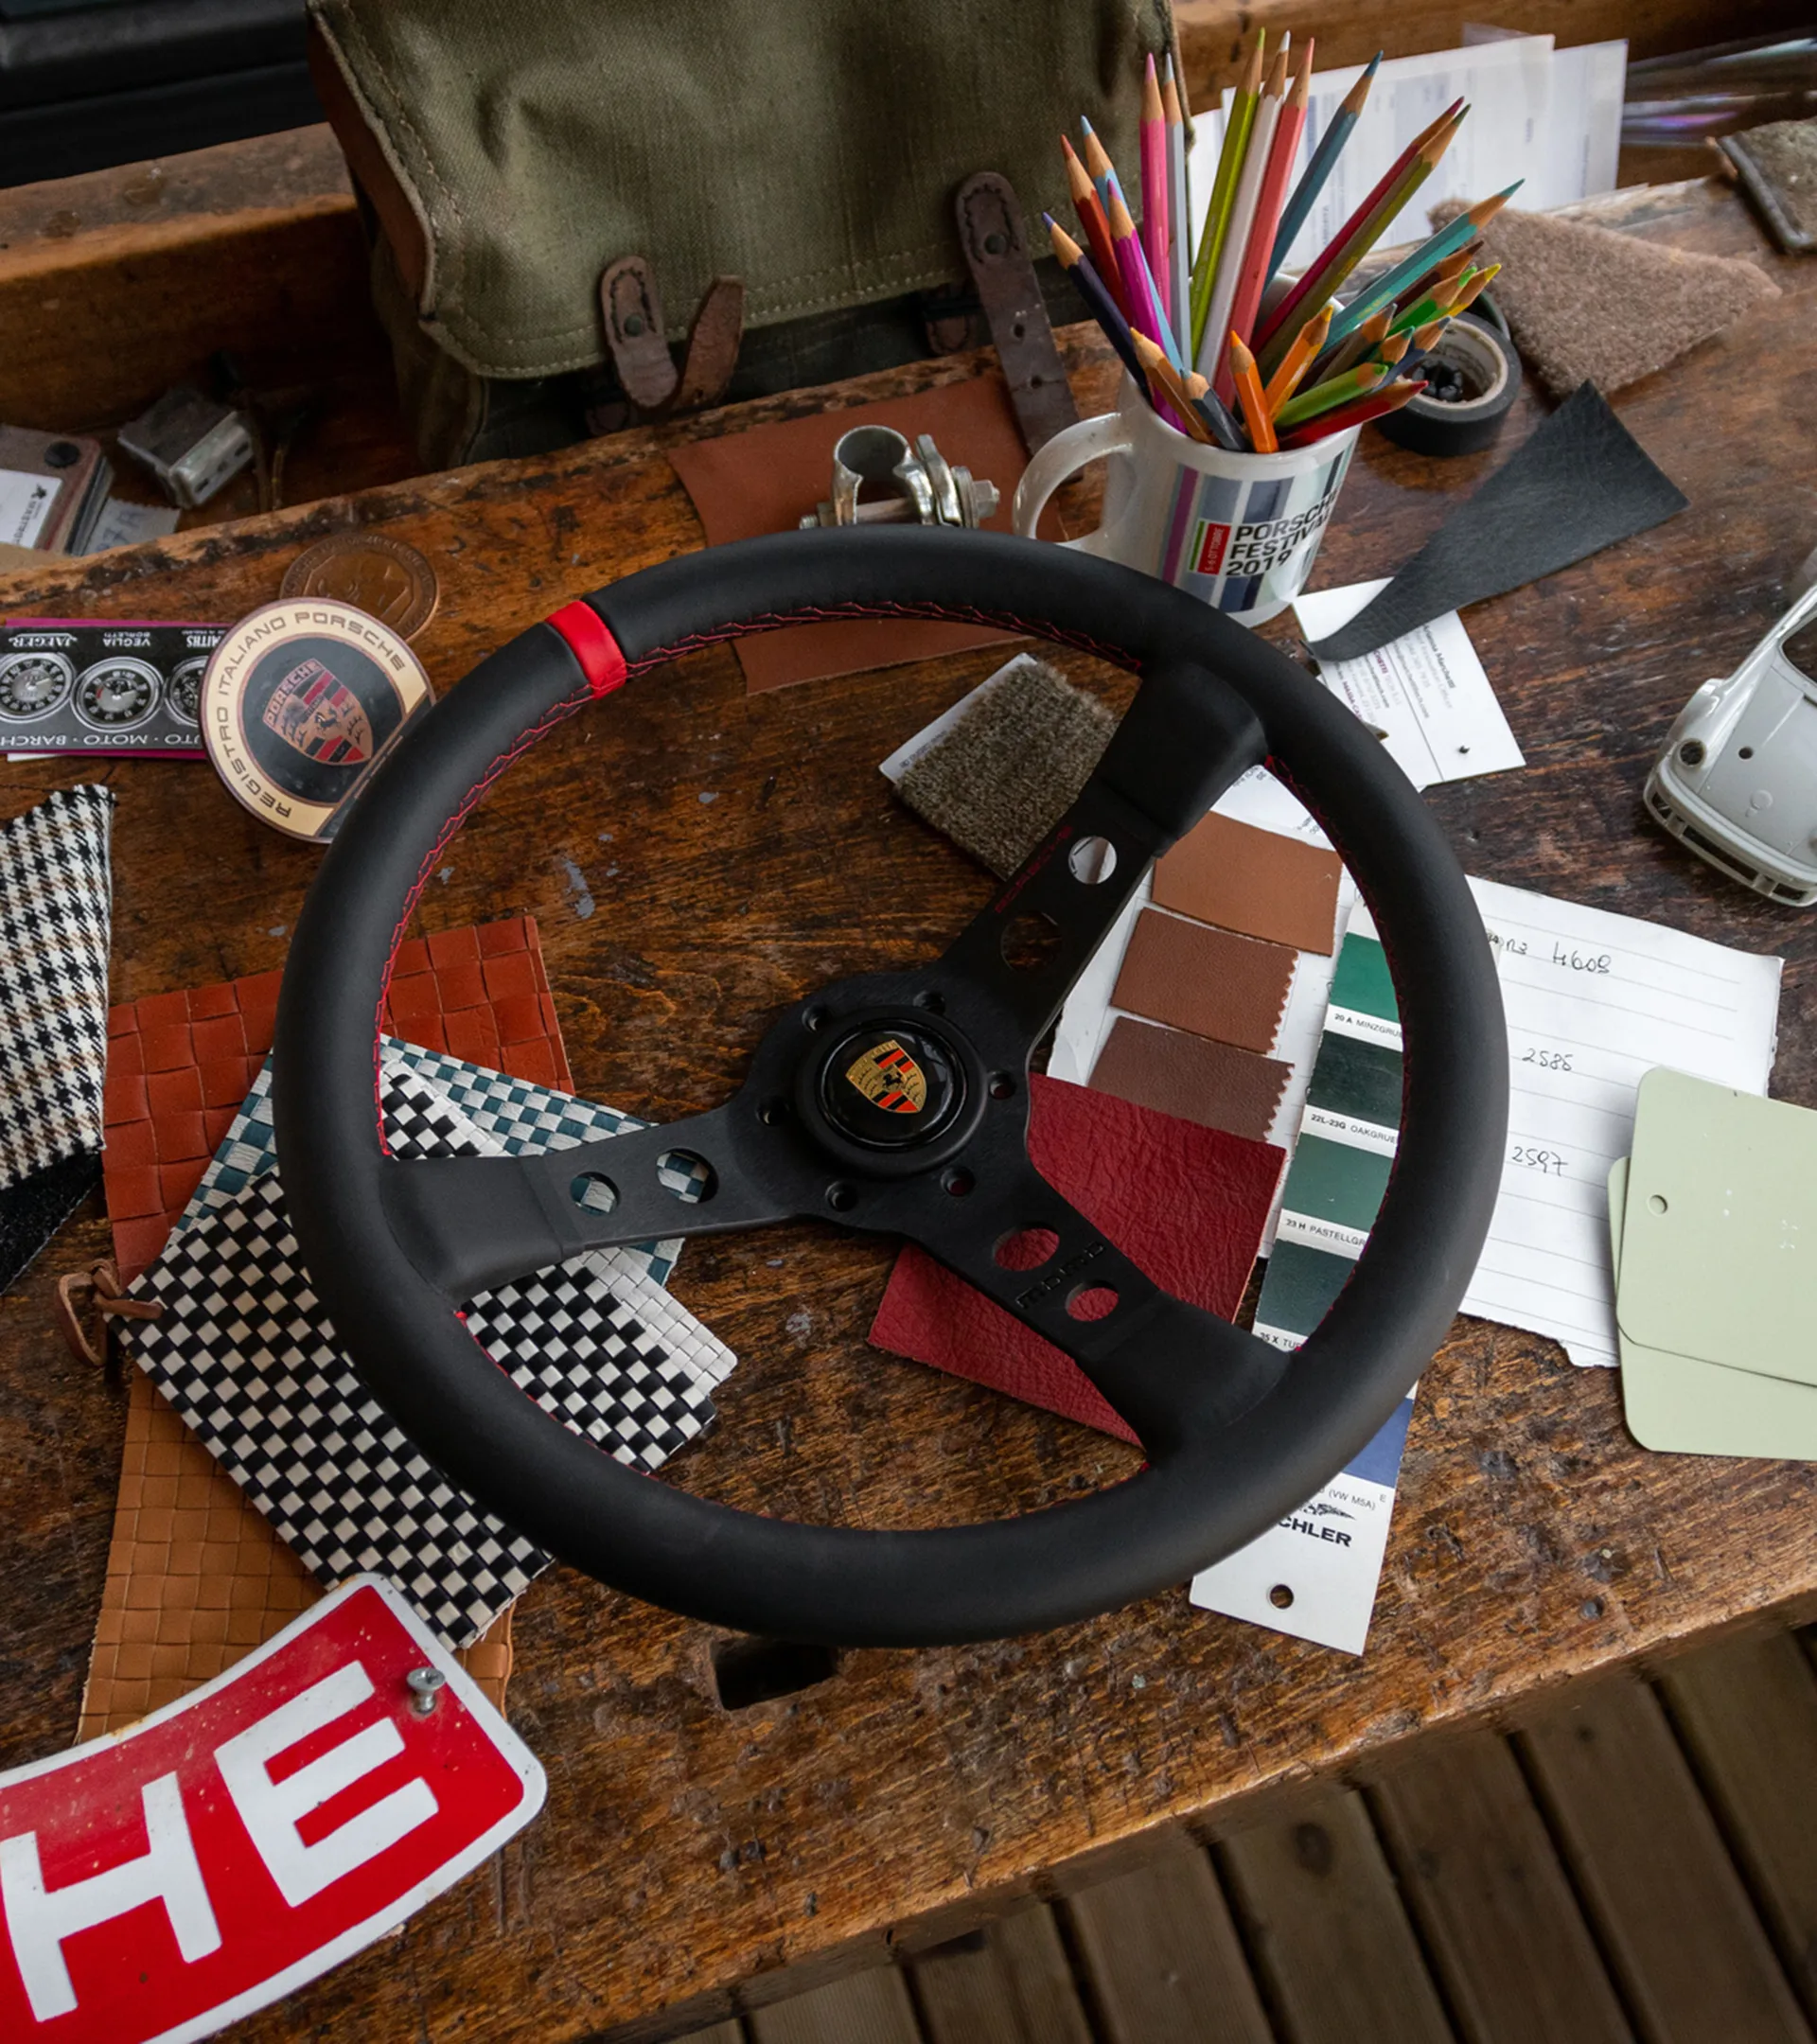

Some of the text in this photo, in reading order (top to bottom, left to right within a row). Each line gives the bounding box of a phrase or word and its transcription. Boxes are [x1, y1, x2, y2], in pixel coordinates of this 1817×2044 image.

[1226, 549, 1293, 576] 2019
[9, 635, 77, 648] JAEGER
[103, 638, 151, 647] VEGLIA
[294, 611, 406, 671] PORSCHE
[218, 616, 287, 696] ITALIANO
[266, 661, 323, 727] PORSCHE
[0, 733, 67, 747] BARCH
[83, 733, 148, 746] MOTO
[217, 706, 291, 818] REGISTRO
[1334, 1013, 1345, 1022] 20
[1511, 1146, 1569, 1177] 2597
[1286, 1218, 1297, 1228] 23
[1298, 1223, 1306, 1231] H
[0, 1660, 439, 2022] HE
